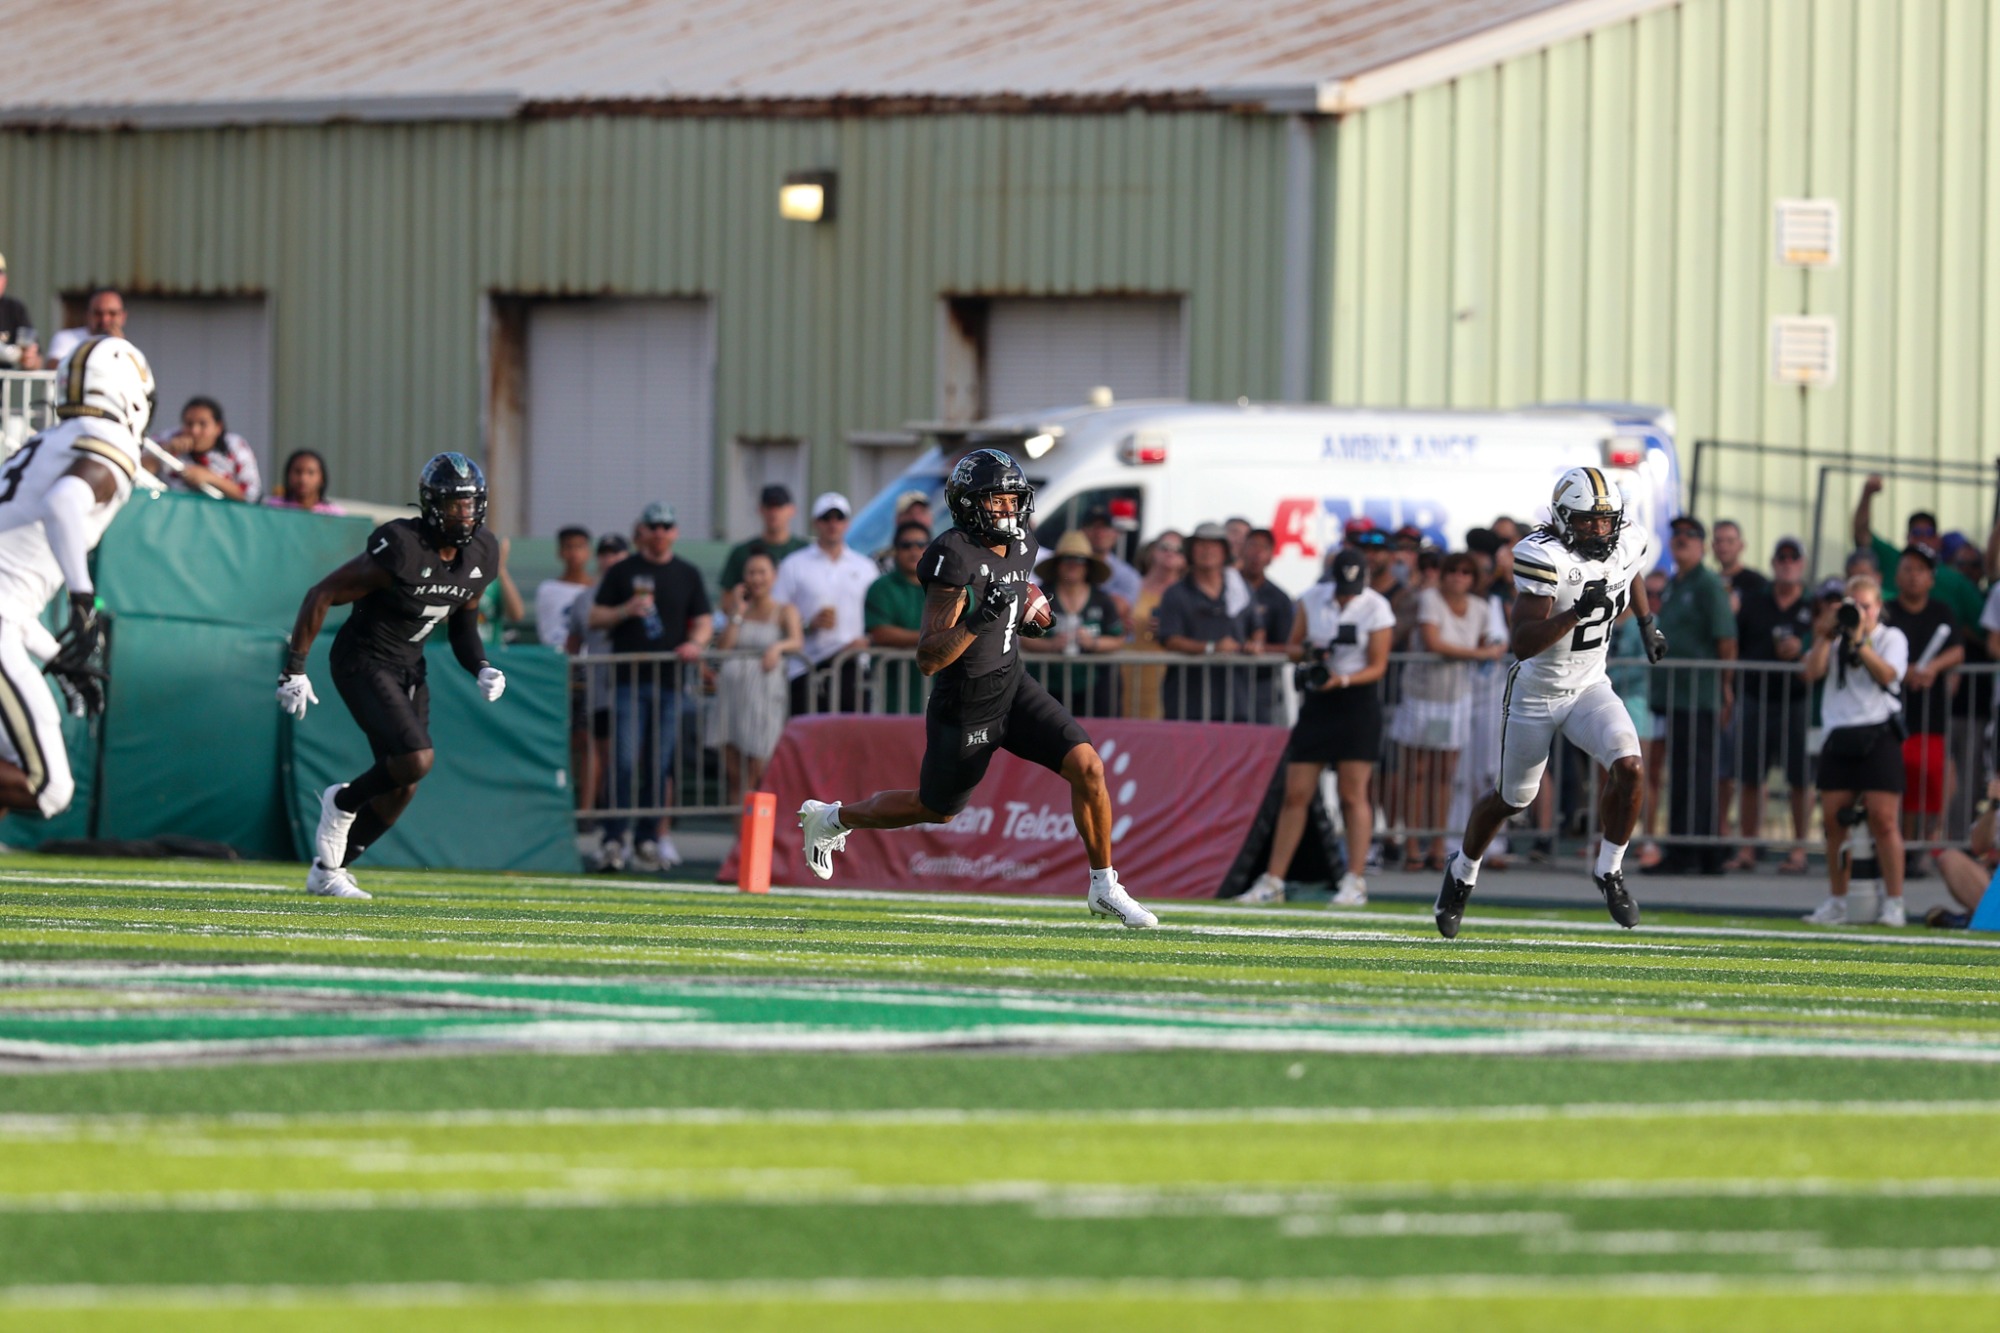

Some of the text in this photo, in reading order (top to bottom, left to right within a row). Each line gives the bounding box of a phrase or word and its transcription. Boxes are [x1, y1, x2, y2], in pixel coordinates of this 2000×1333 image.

[1321, 432, 1479, 462] AMBULANCE
[372, 537, 389, 555] 7
[933, 554, 945, 577] 1
[408, 605, 451, 642] 7
[1003, 594, 1019, 654] 1
[1571, 589, 1625, 652] 21
[1002, 801, 1078, 841] Telco
